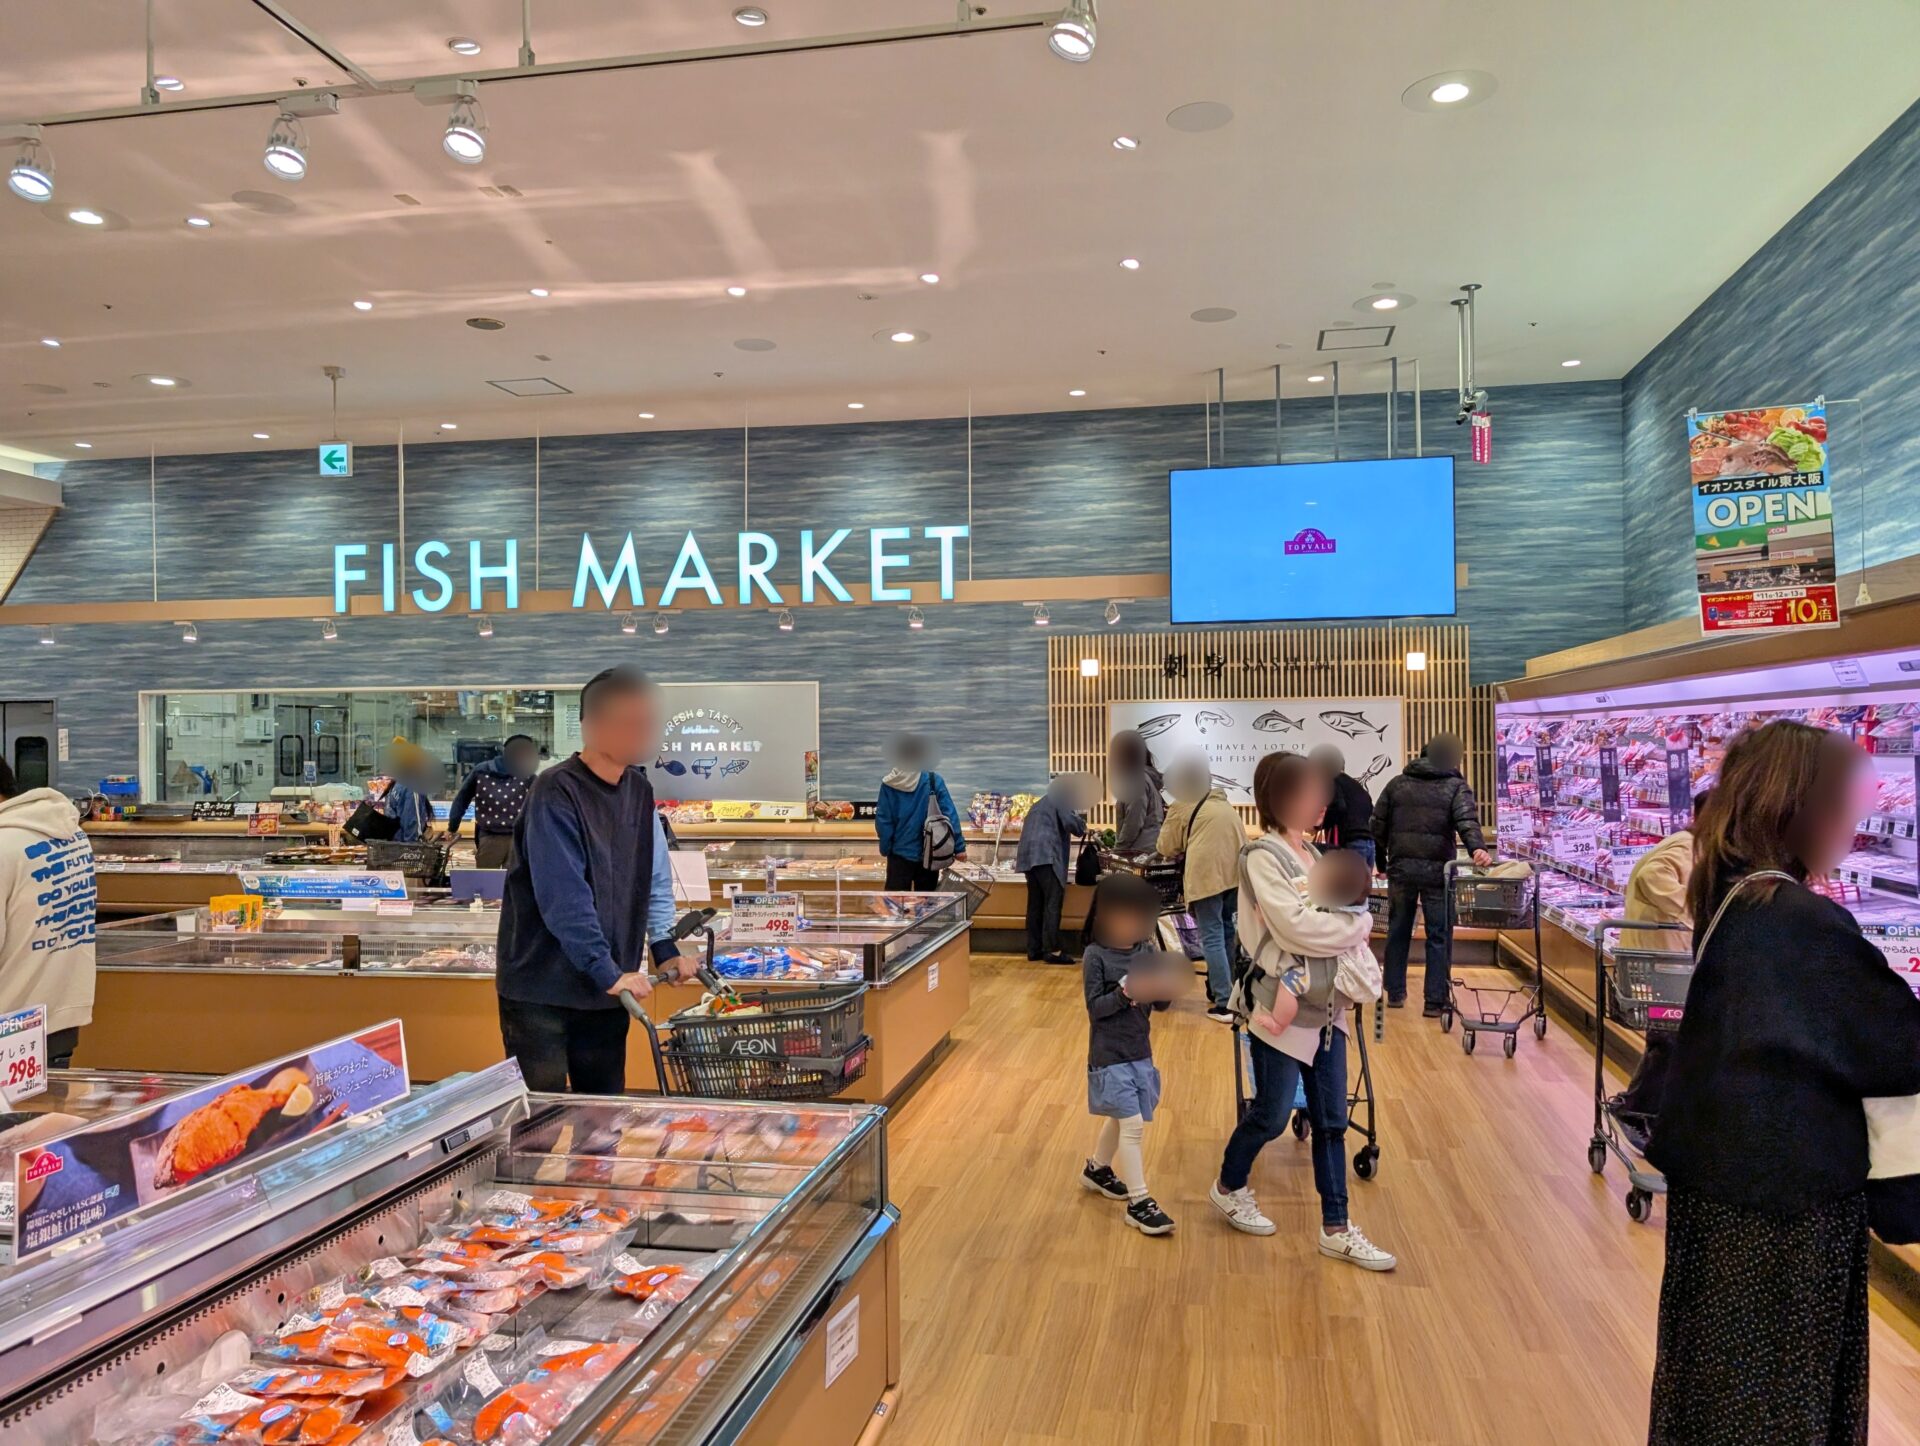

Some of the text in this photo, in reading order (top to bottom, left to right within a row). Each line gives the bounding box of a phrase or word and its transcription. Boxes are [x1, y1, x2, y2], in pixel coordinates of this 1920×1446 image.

[1699, 473, 1822, 494] イオンスタイル東大阪
[1706, 490, 1817, 528] OPEN
[1287, 543, 1333, 551] TOPVALU
[333, 525, 969, 613] FISH MARKET
[1748, 609, 1775, 618] ポイント
[708, 709, 743, 734] TASTY
[690, 740, 763, 752] MARKET
[1216, 743, 1246, 751] HAVE
[1251, 743, 1258, 751] A
[1264, 743, 1289, 751] LOT
[1292, 743, 1307, 751] OF
[1229, 754, 1256, 763] FISH
[64, 878, 89, 896] YOU
[755, 896, 780, 904] OPEN
[60, 924, 86, 941] YOU
[1662, 1009, 1684, 1019] AEO
[0, 1015, 23, 1036] PEN
[315, 1056, 369, 1087] 旨味がつまった
[29, 1161, 61, 1178] TOPVALU
[26, 1191, 104, 1230] 環境にやさしいASC認証
[26, 1203, 107, 1249] 塩銀鮭(甘塩味)
